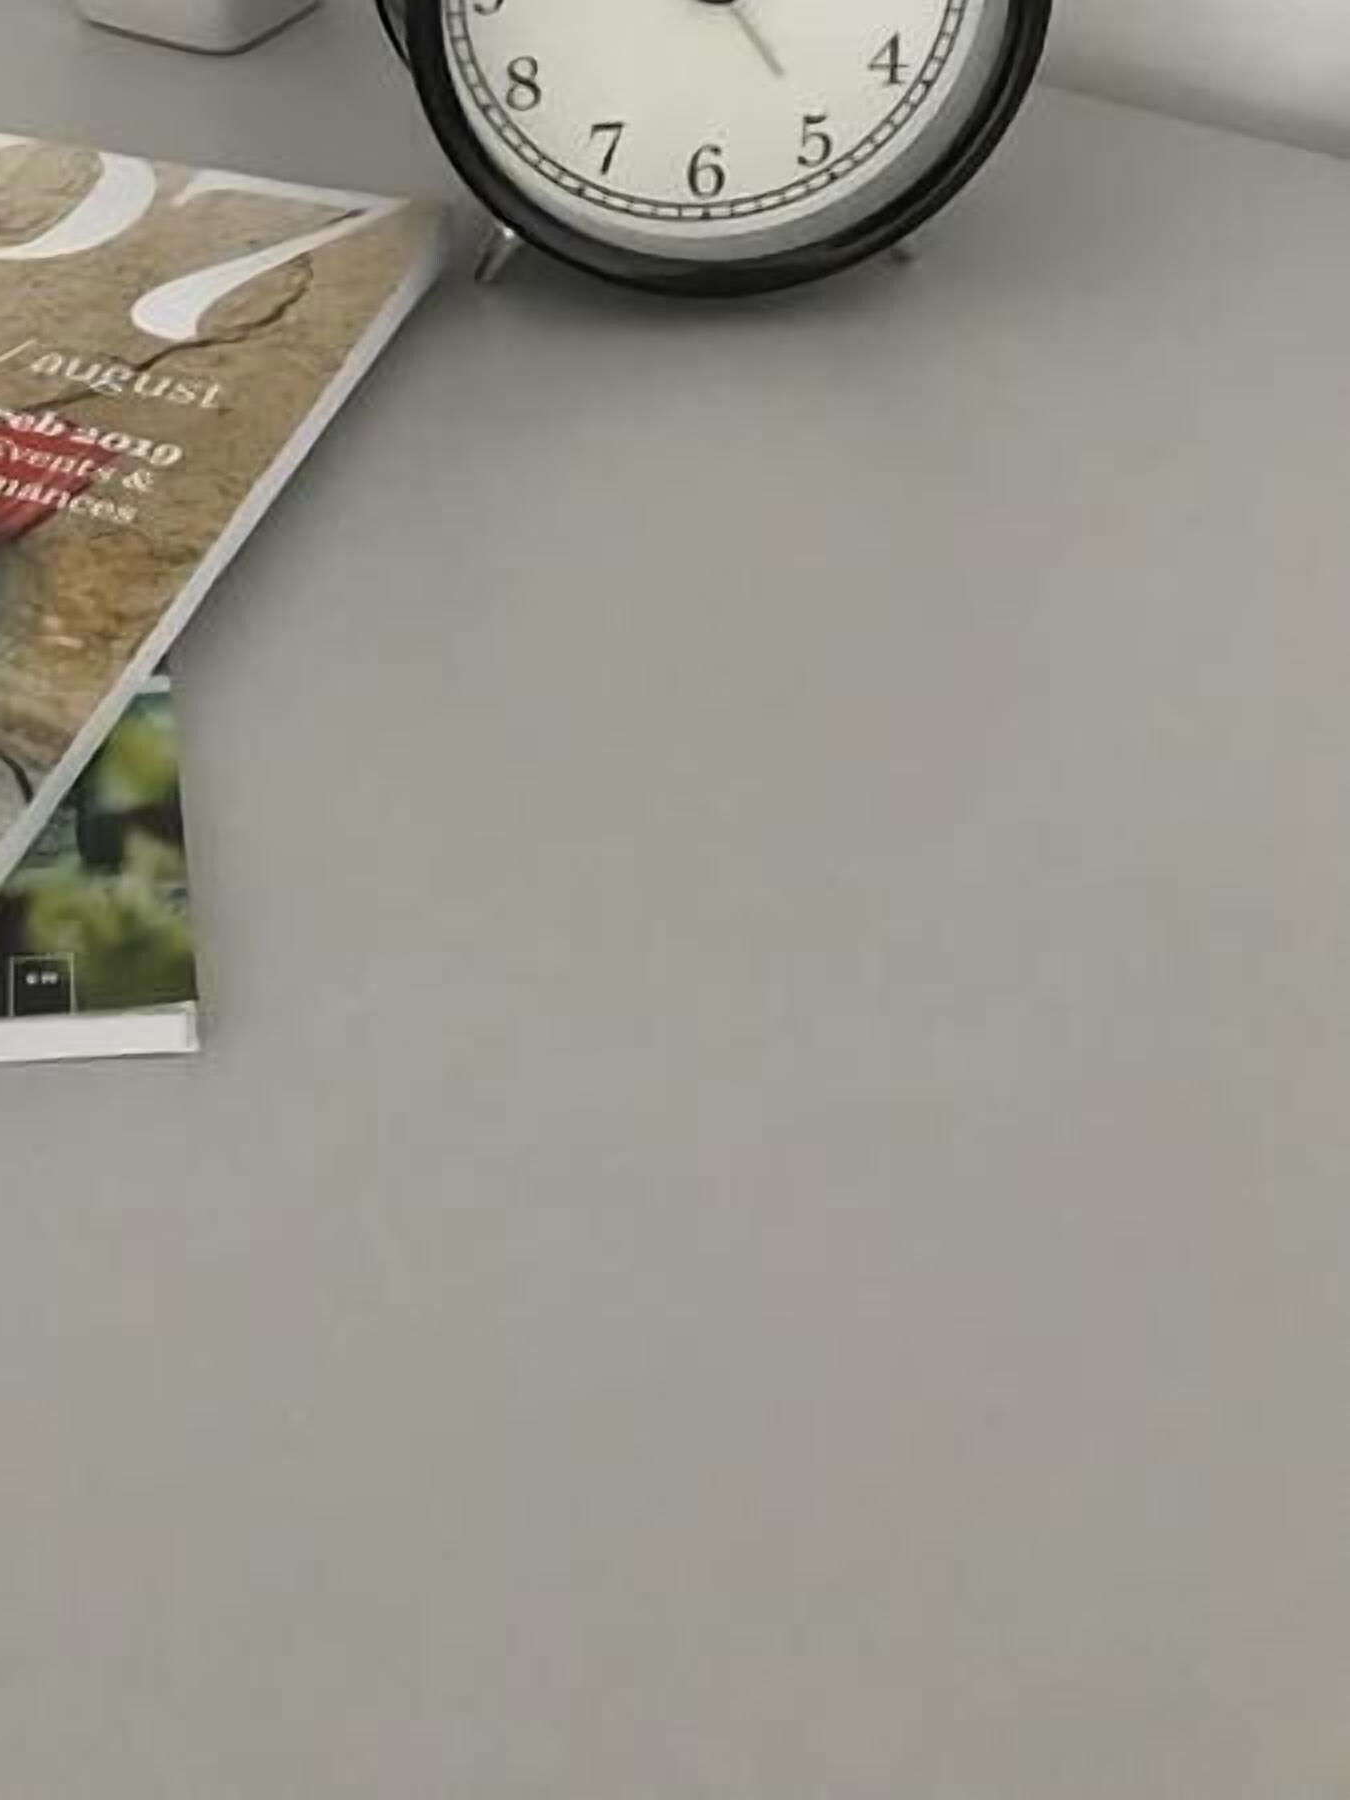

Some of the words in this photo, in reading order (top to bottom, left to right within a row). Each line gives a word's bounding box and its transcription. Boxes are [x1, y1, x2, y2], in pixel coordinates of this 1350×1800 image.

[505, 56, 542, 111] 8
[867, 34, 910, 85] 4
[589, 121, 626, 176] 7
[797, 115, 834, 169] 5
[686, 144, 727, 198] 6
[29, 350, 222, 409] august
